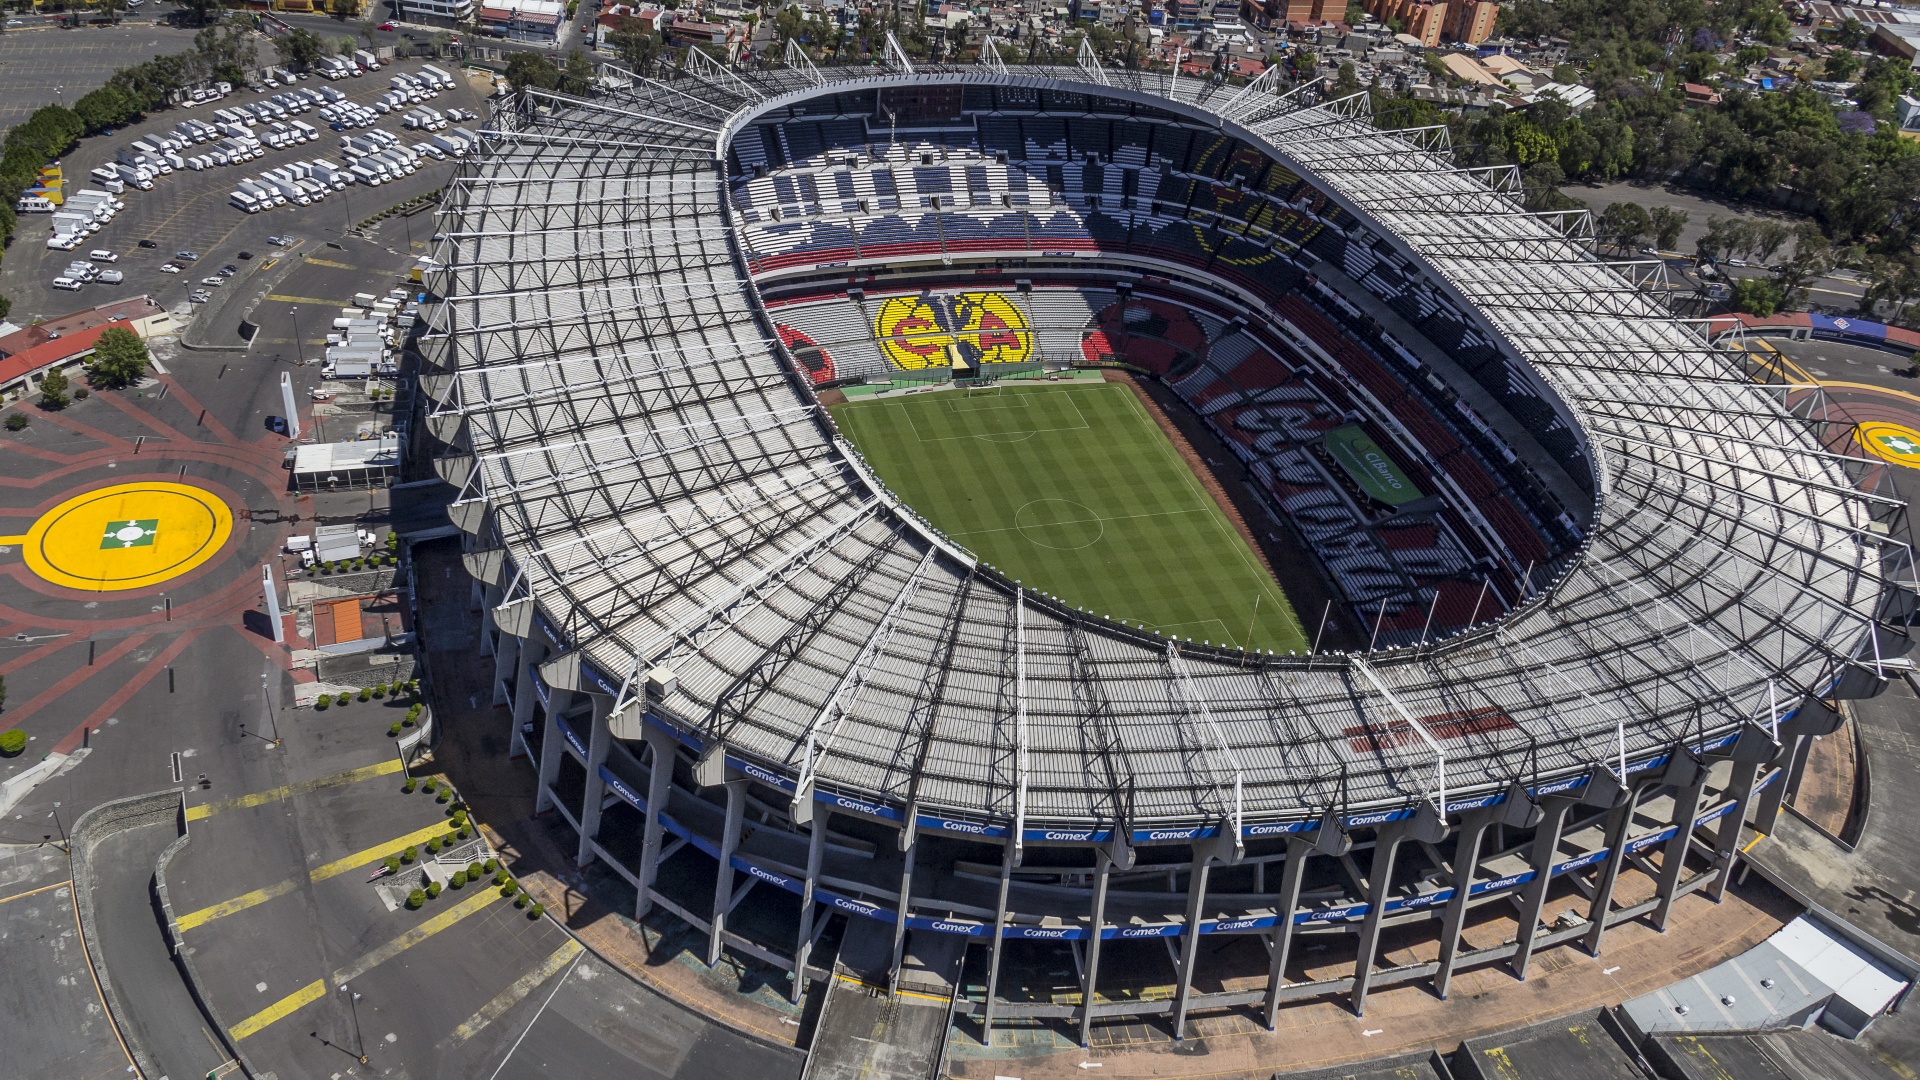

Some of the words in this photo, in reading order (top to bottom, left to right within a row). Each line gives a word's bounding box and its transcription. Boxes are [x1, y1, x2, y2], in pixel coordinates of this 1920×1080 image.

[1365, 452, 1402, 489] CIBanco
[543, 625, 564, 651] Comx
[566, 731, 586, 757] Comex
[744, 765, 785, 786] Comex
[613, 780, 640, 805] Comex
[1537, 780, 1575, 795] Comex
[837, 798, 882, 815] Comex
[1447, 798, 1487, 812] Comex
[1349, 812, 1392, 826] Comex
[1697, 807, 1725, 825] Comex
[943, 821, 990, 834] Comex
[1149, 829, 1196, 840] Comex
[1250, 823, 1294, 835] Comex
[1045, 831, 1093, 841] Comex
[1632, 832, 1664, 849] Comex
[1561, 854, 1594, 871] Comex
[750, 866, 788, 886] Comex
[1485, 874, 1522, 890] Comex
[834, 898, 877, 915] Comex
[1400, 893, 1438, 907] Comex
[1311, 908, 1351, 920] Comex
[931, 921, 975, 933] Comex
[1122, 926, 1166, 937] Comex
[1216, 918, 1258, 930] Comex
[1023, 928, 1068, 938] Comex
